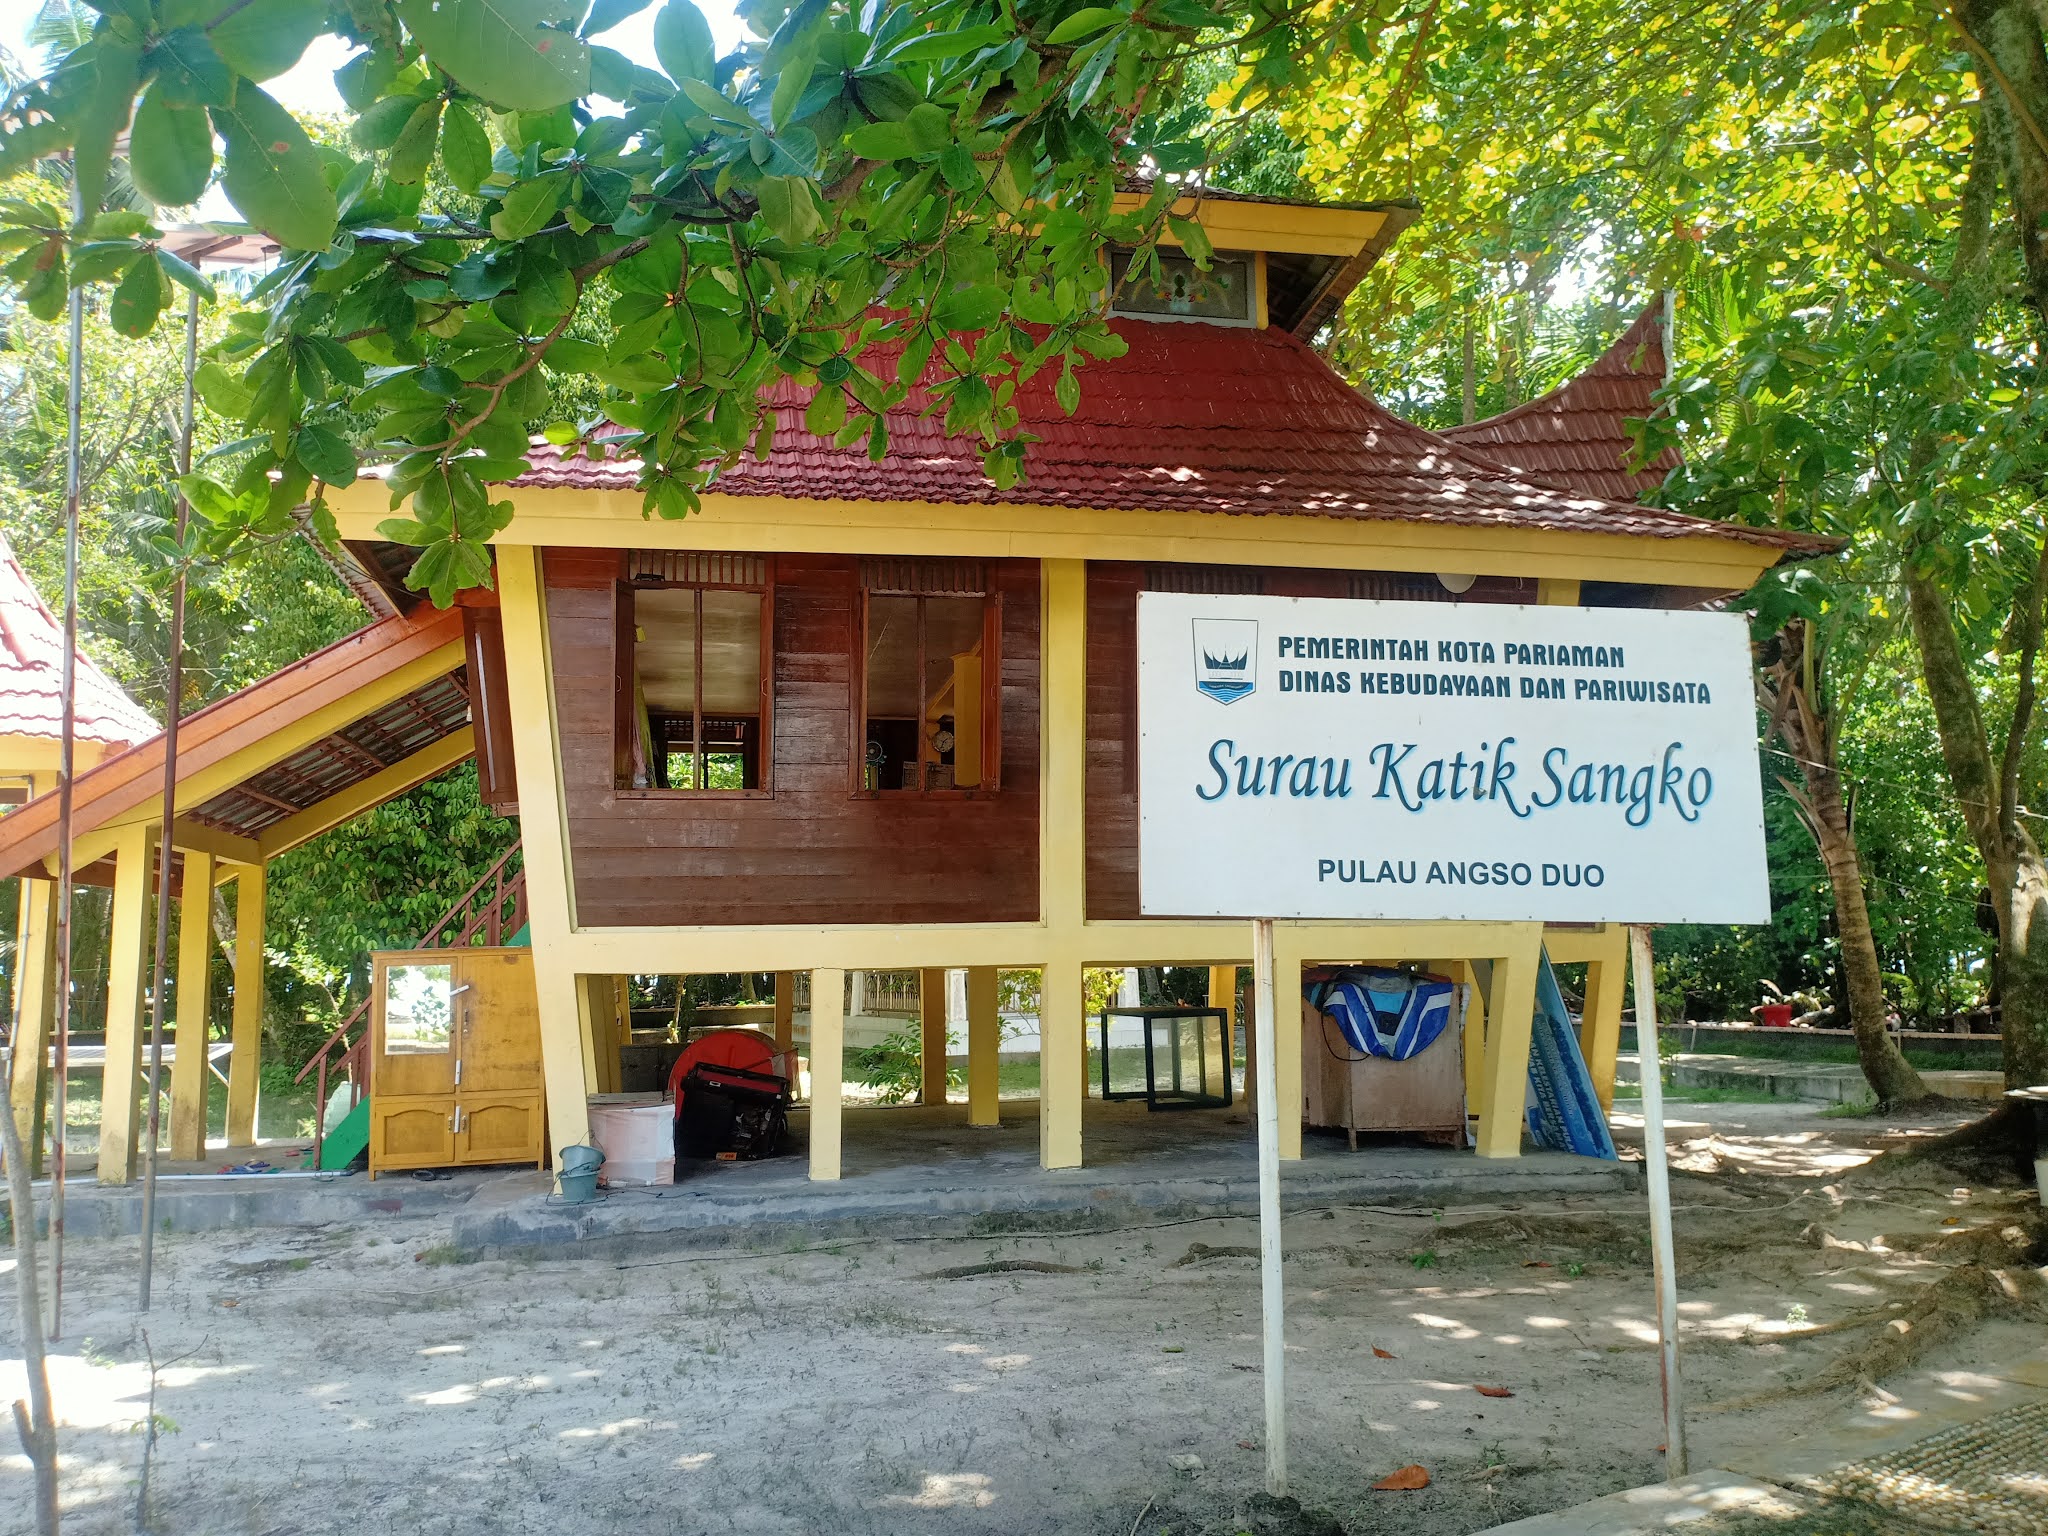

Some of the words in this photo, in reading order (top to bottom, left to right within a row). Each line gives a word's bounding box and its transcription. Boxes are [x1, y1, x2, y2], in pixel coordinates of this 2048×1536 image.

[1278, 636, 1429, 662] PEMERINTAH
[1437, 640, 1496, 664] KOTA
[1503, 642, 1625, 668] PARIAMAN
[1278, 670, 1351, 694] DINAS
[1360, 672, 1511, 698] KEBUDAYAAN
[1519, 676, 1566, 700] DAN
[1574, 678, 1711, 705] PARIWISATA
[1195, 738, 1352, 801] Surau
[1368, 736, 1532, 818] Katik
[1524, 741, 1712, 827] Sangko
[1318, 859, 1417, 884] PULAU
[1425, 861, 1532, 886] ANGSO
[1541, 863, 1605, 888] DUO
